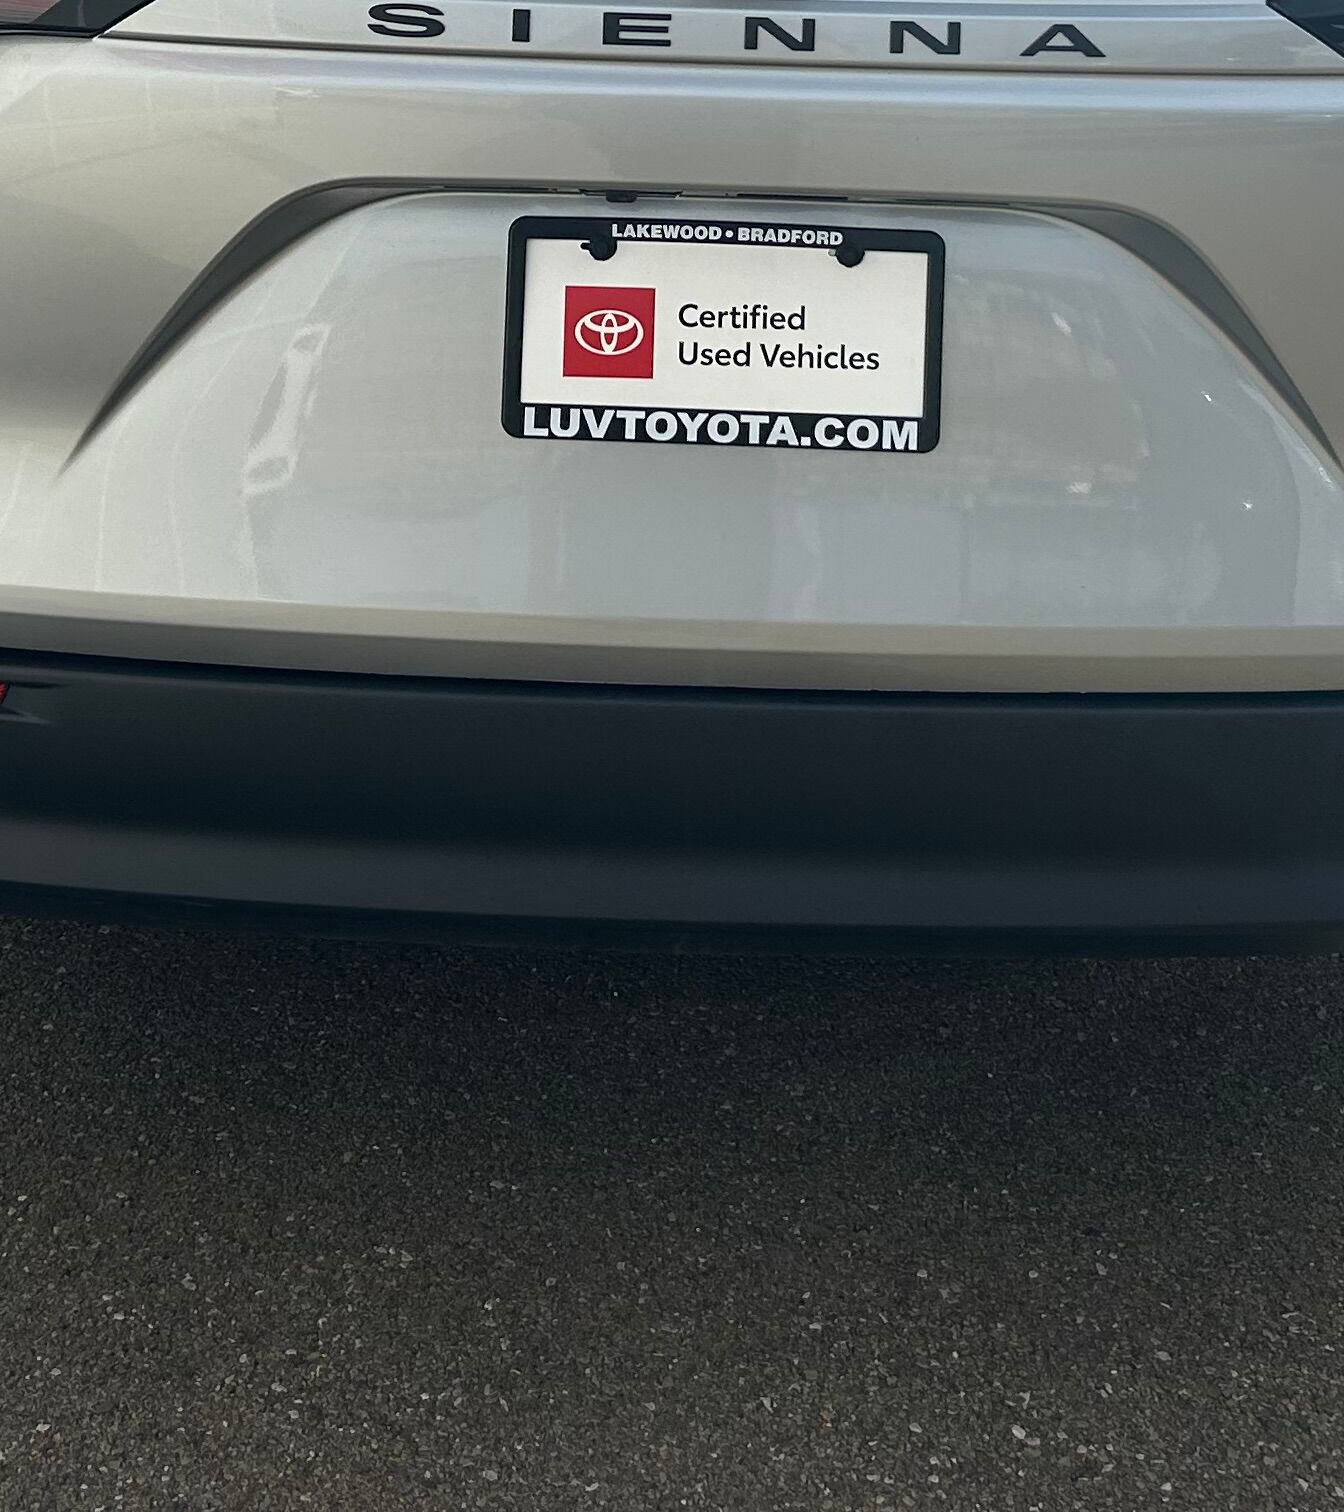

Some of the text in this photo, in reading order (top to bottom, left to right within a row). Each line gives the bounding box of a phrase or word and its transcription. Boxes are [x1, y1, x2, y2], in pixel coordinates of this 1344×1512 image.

[367, 3, 1107, 58] SIENNA
[611, 223, 844, 246] LAKEWOOD BRADFORD
[678, 304, 806, 330] Certified
[678, 342, 880, 370] Used Vehicles
[523, 406, 919, 452] LUVTOYOTA.COM
